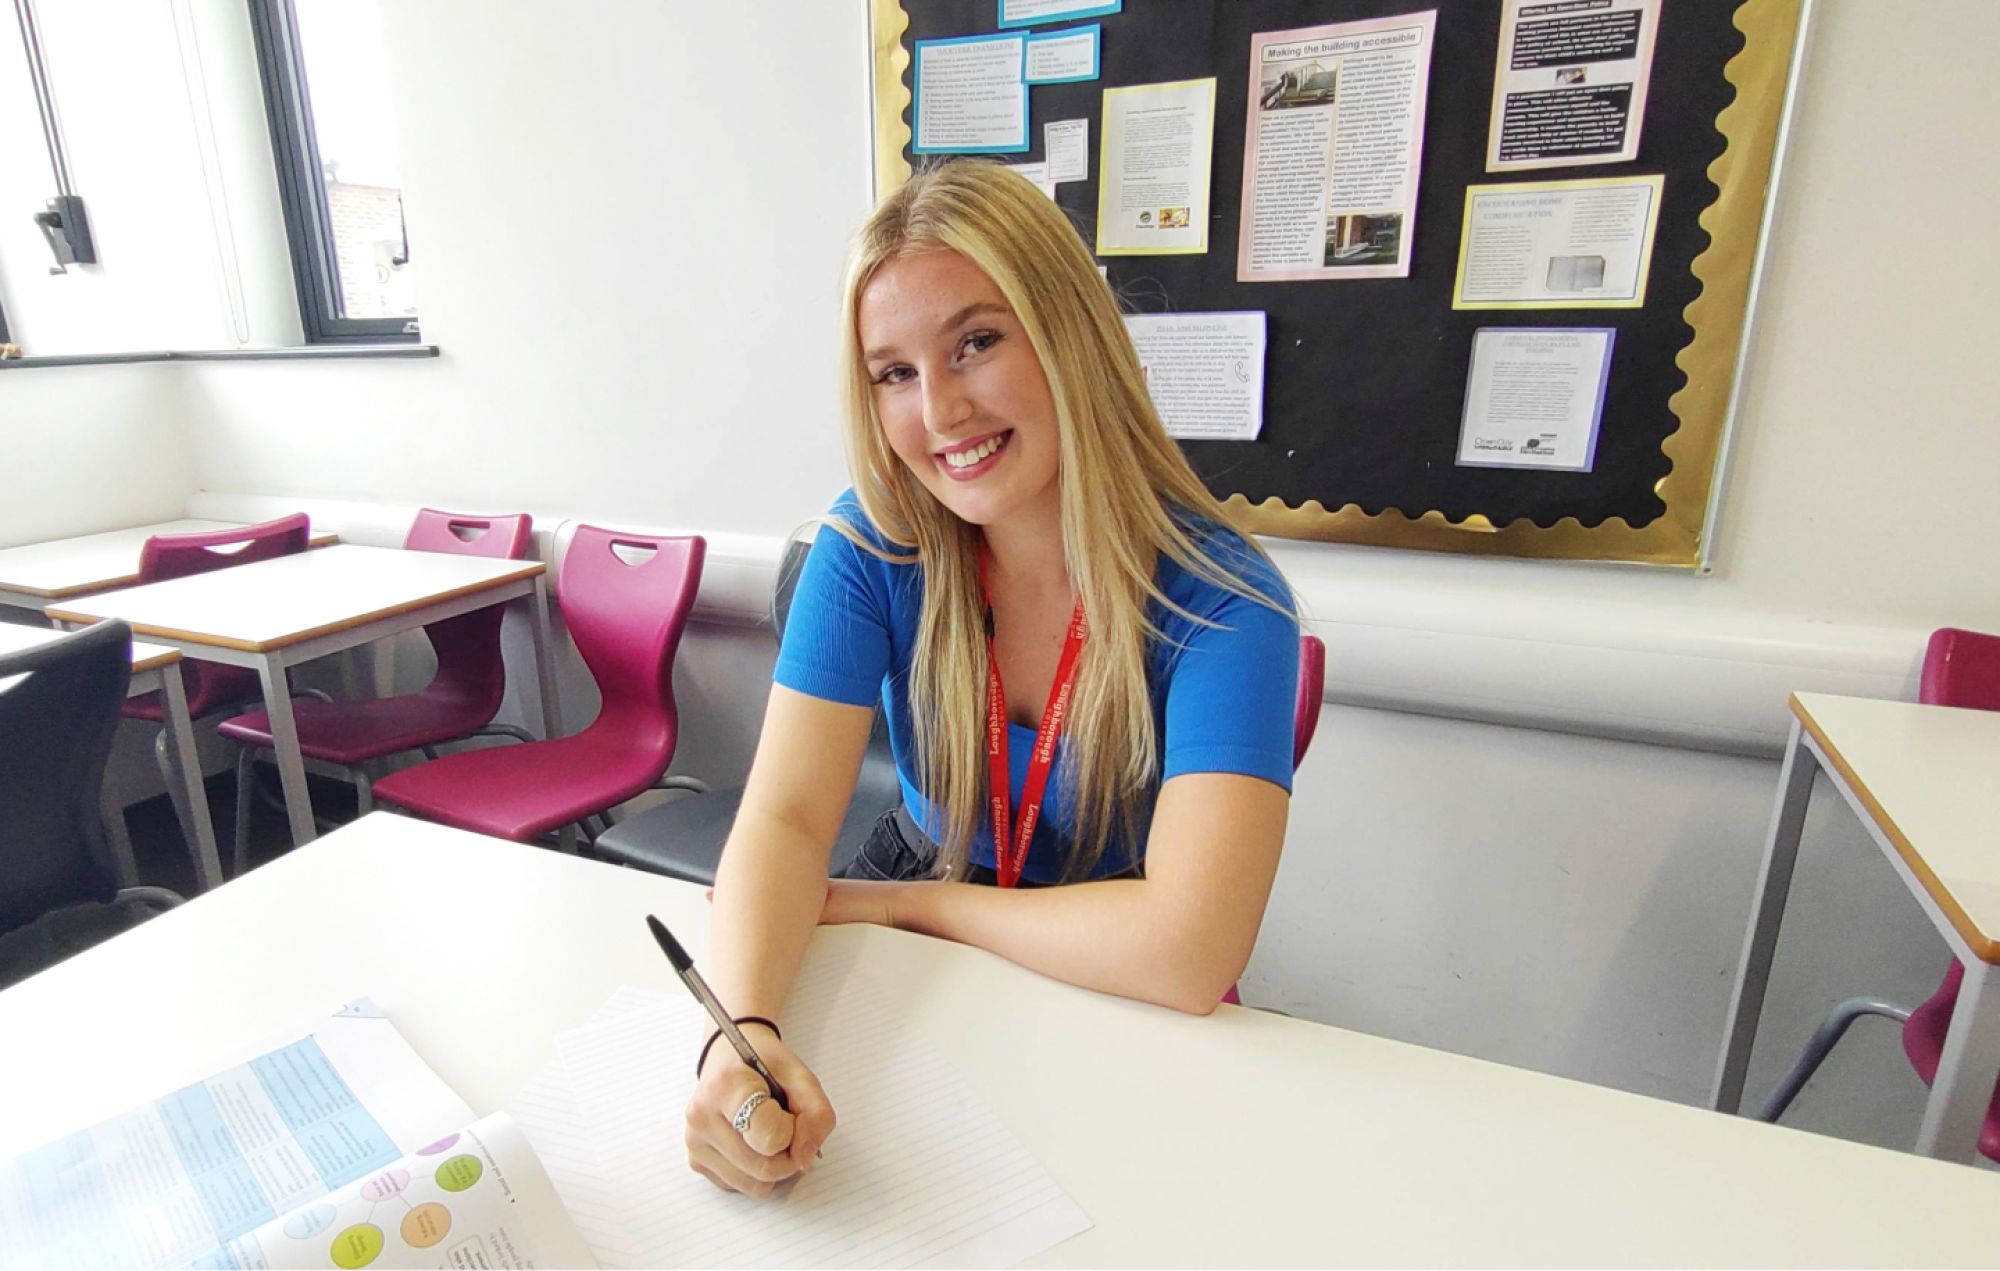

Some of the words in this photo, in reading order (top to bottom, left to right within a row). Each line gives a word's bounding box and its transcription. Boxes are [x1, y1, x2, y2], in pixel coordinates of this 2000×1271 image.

[1267, 46, 1302, 59] Making
[1303, 45, 1319, 54] the
[1321, 39, 1361, 53] building
[1362, 32, 1416, 48] accessible
[989, 674, 1000, 755] Loughborough
[1040, 683, 1071, 764] Loughborough
[992, 796, 1002, 870] Loughborough
[1013, 803, 1039, 872] Loughborough
